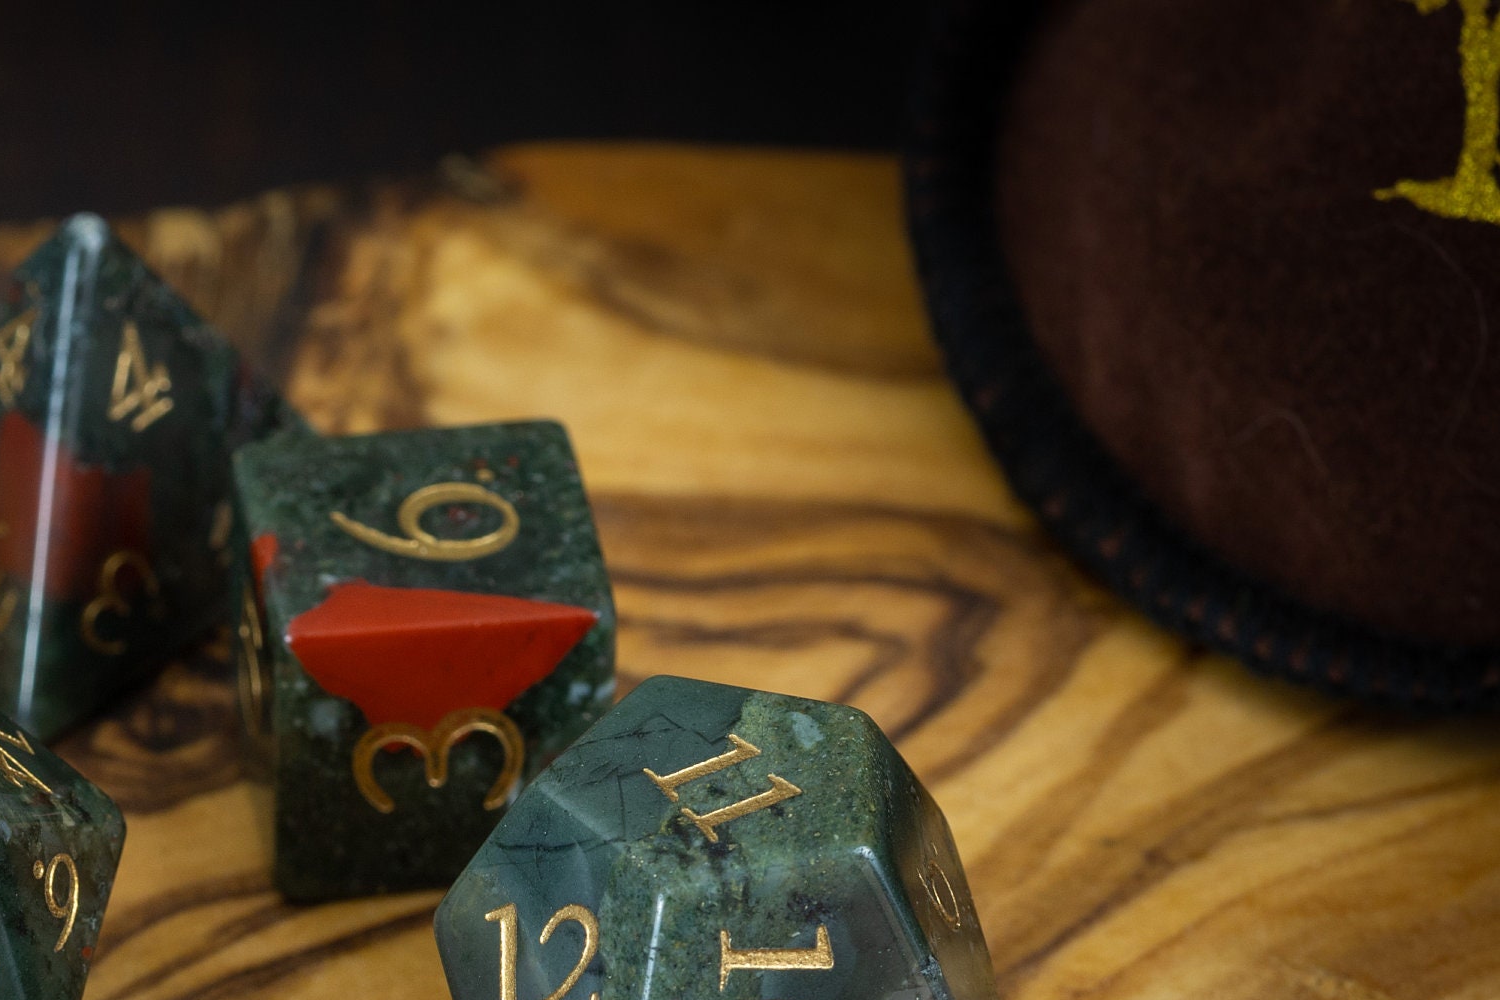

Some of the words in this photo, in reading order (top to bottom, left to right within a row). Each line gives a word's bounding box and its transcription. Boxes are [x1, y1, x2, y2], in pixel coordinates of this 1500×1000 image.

[105, 320, 175, 433] 4
[352, 706, 526, 815] 3
[643, 733, 803, 844] 11
